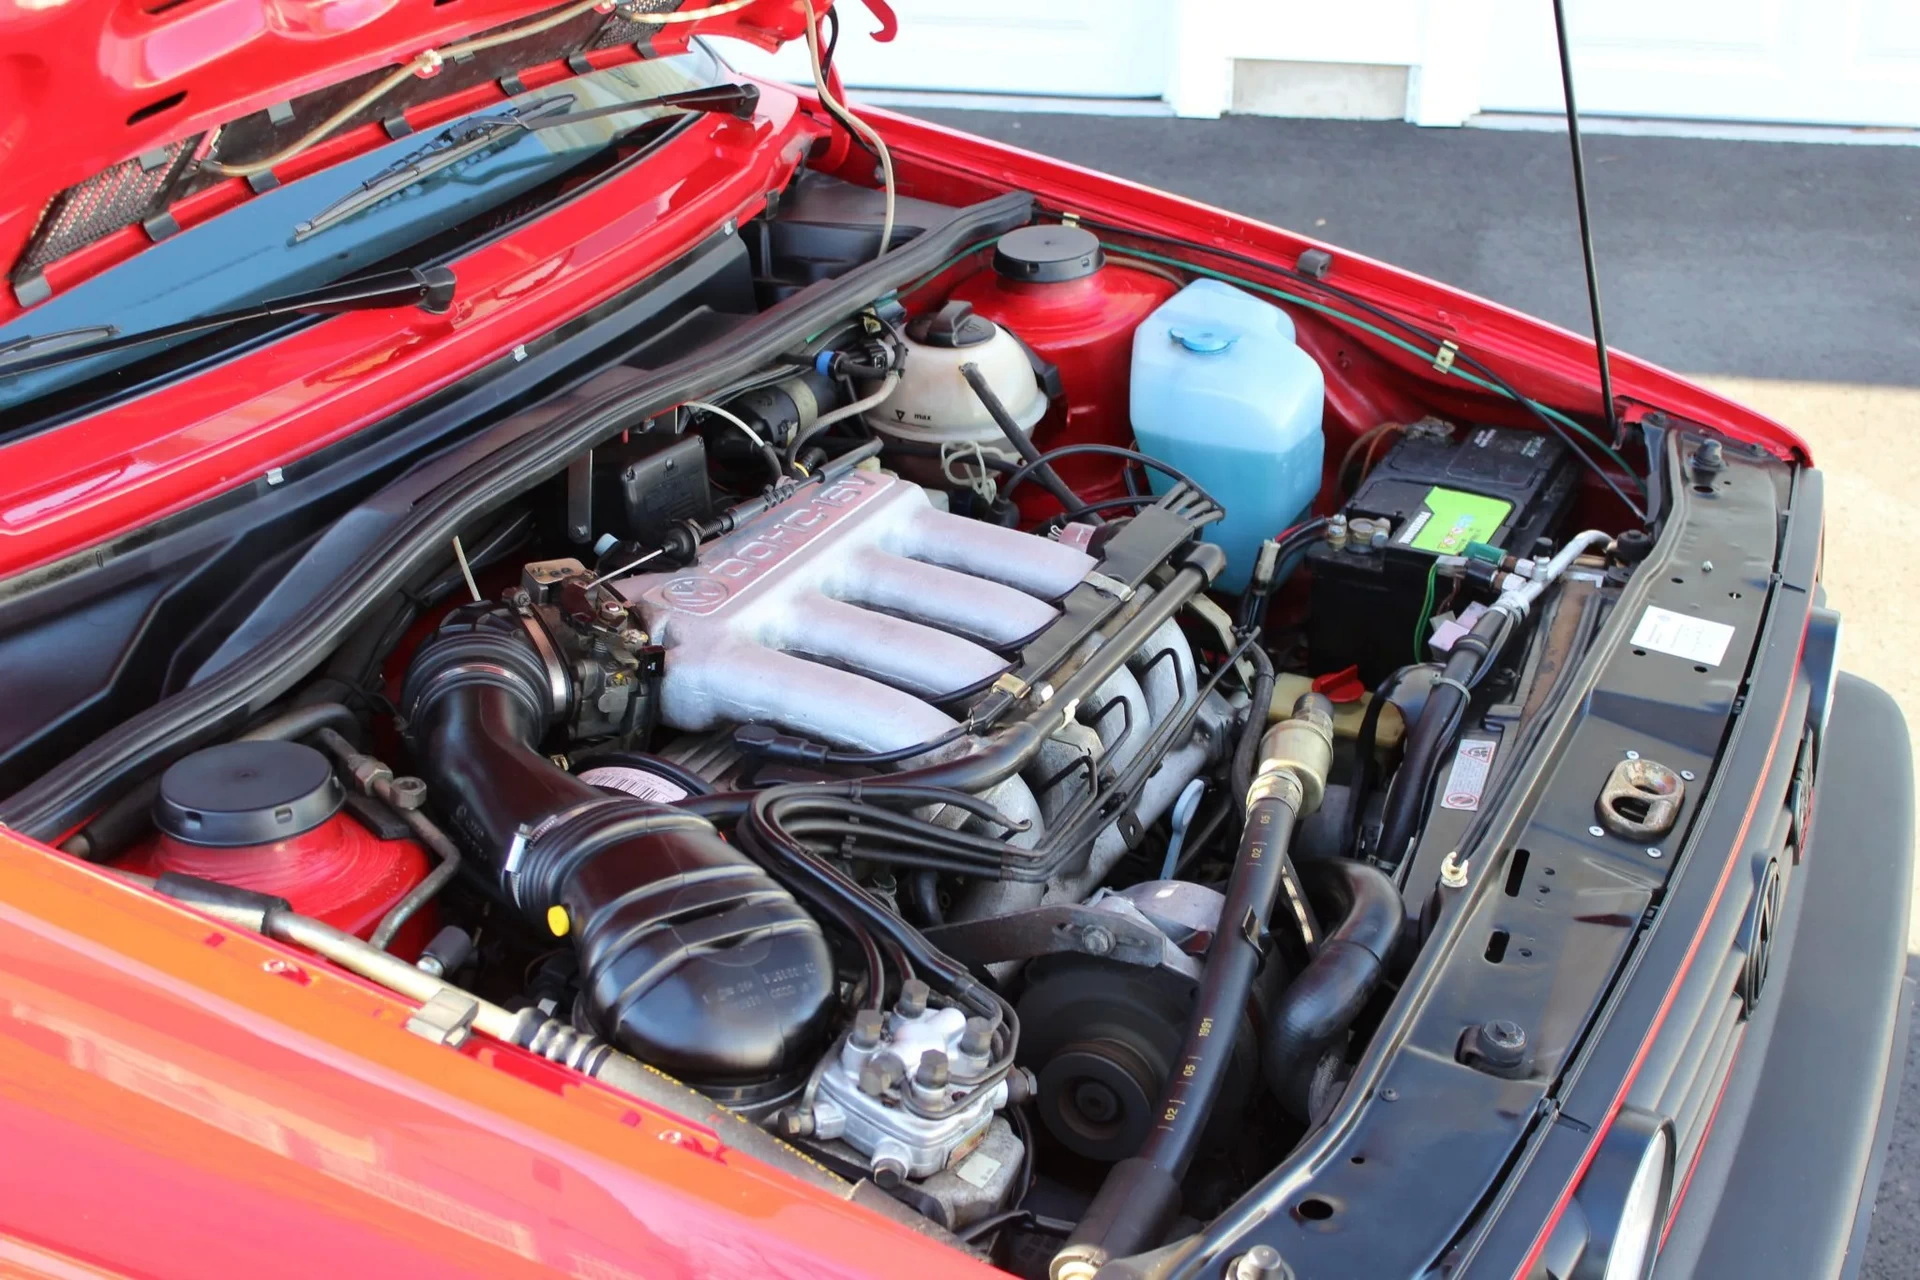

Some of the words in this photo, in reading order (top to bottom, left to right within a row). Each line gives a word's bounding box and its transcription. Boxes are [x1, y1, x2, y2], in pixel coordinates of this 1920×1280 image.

[914, 413, 931, 421] max
[1252, 847, 1262, 860] 02
[1164, 1107, 1178, 1121] 02
[1183, 1063, 1197, 1078] 05
[1198, 1017, 1214, 1038] 1991
